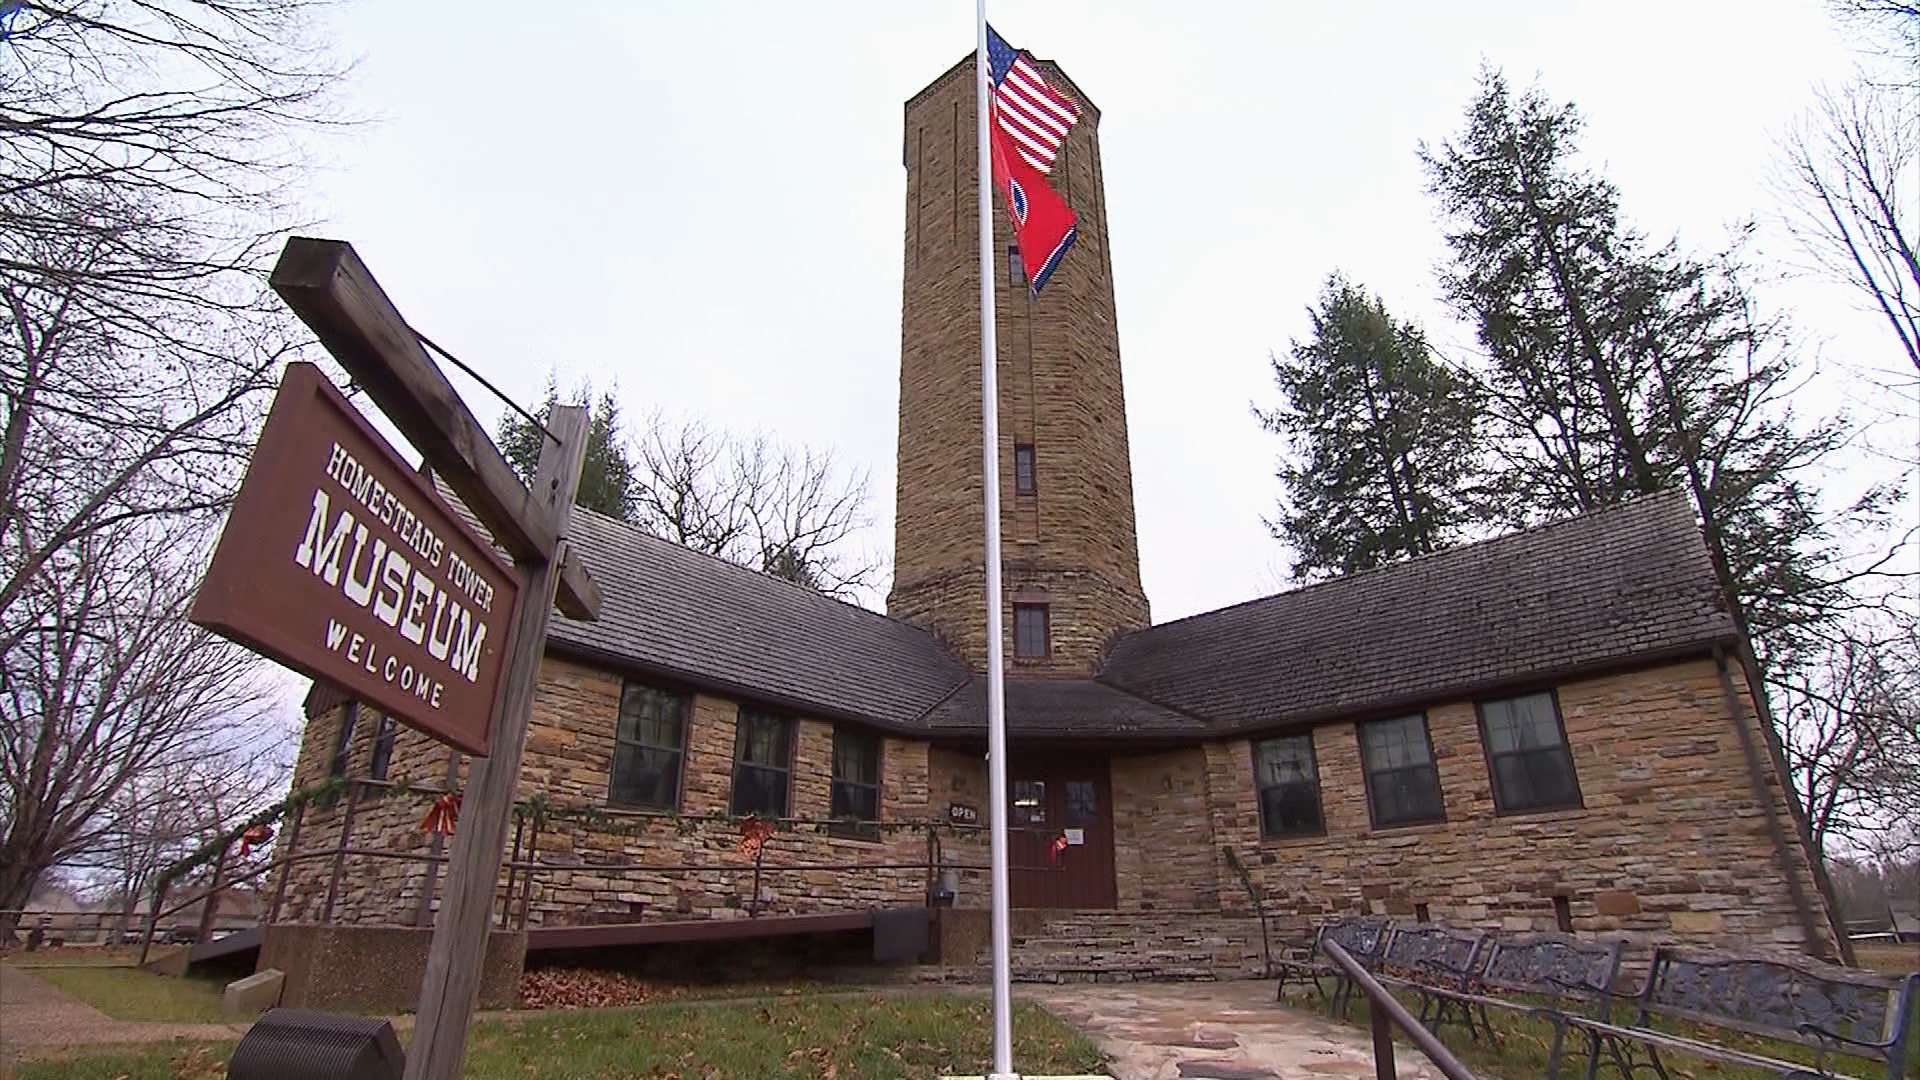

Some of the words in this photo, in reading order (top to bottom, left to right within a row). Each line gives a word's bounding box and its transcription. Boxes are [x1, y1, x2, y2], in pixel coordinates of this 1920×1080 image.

[295, 488, 487, 683] MUSEUM
[325, 442, 445, 568] HOMESTEADS
[447, 551, 494, 612] TOWER
[326, 619, 444, 709] WELCOME
[951, 806, 977, 820] OPEN
